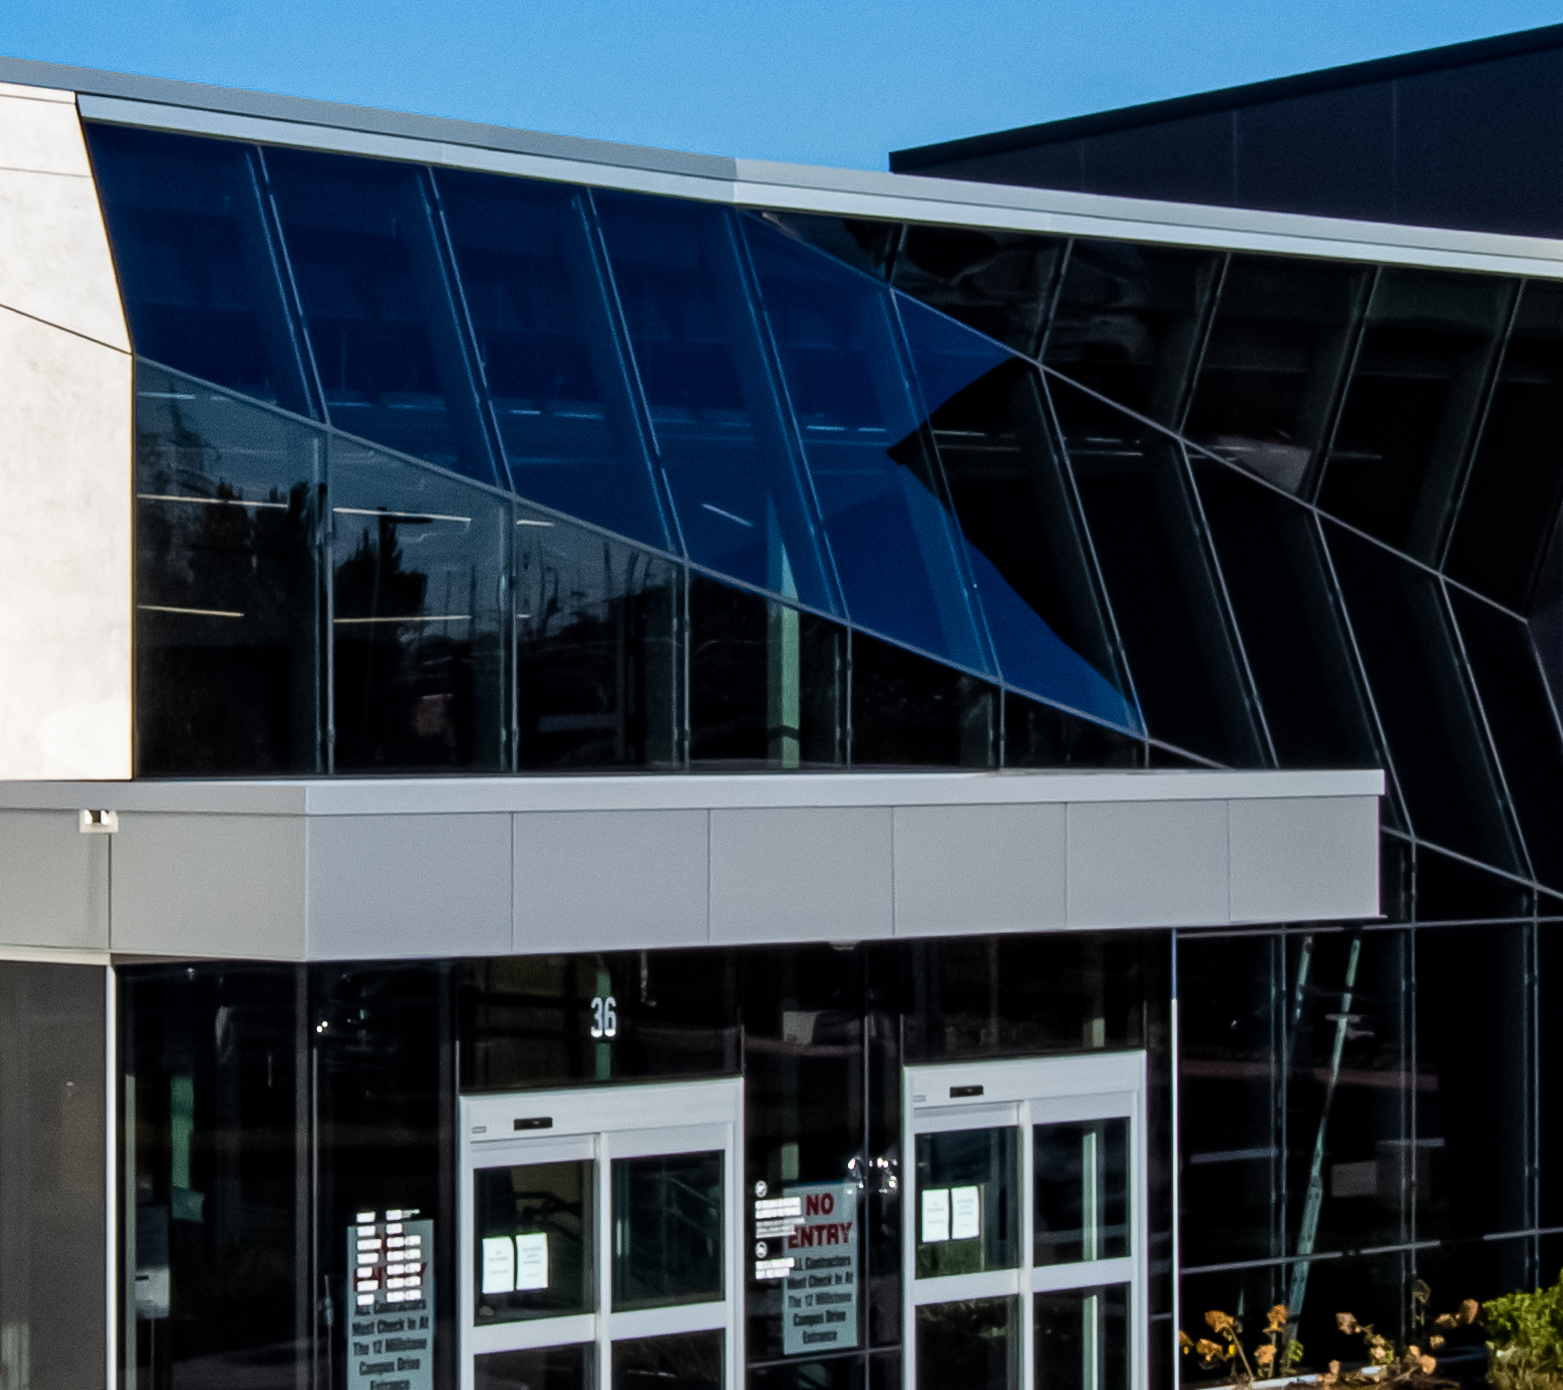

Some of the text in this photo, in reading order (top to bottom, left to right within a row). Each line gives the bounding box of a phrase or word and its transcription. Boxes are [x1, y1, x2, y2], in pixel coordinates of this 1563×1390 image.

[591, 996, 616, 1038] 36
[805, 1192, 835, 1216] NO
[788, 1222, 852, 1249] ENTRY
[377, 1319, 405, 1334] Check
[353, 1342, 370, 1356] The
